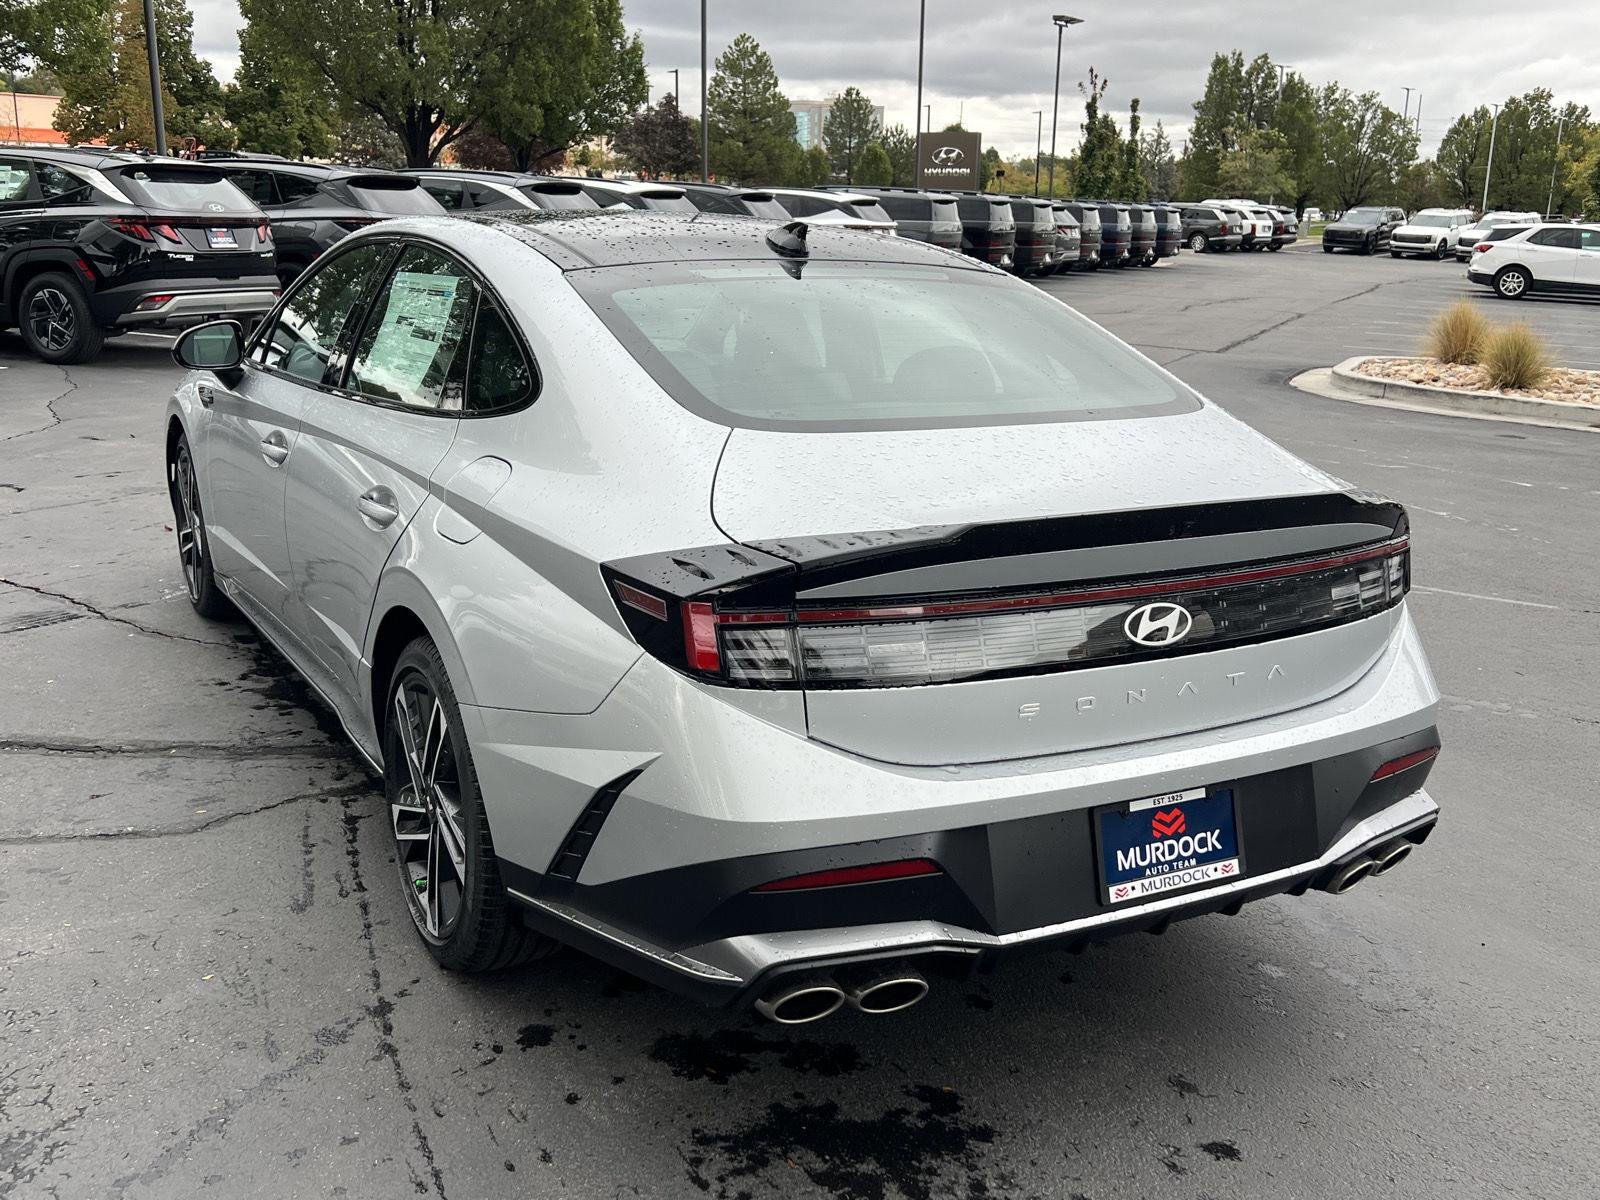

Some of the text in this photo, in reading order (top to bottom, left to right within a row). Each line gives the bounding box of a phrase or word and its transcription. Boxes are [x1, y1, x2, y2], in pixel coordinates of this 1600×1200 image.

[924, 167, 970, 177] HYUNDAI
[1018, 664, 1285, 718] SONATA
[1167, 793, 1184, 803] 1925
[1116, 829, 1222, 872] MURDOCK
[1145, 857, 1197, 877] AUTO TEAM
[1140, 867, 1212, 894] MURDOCK
